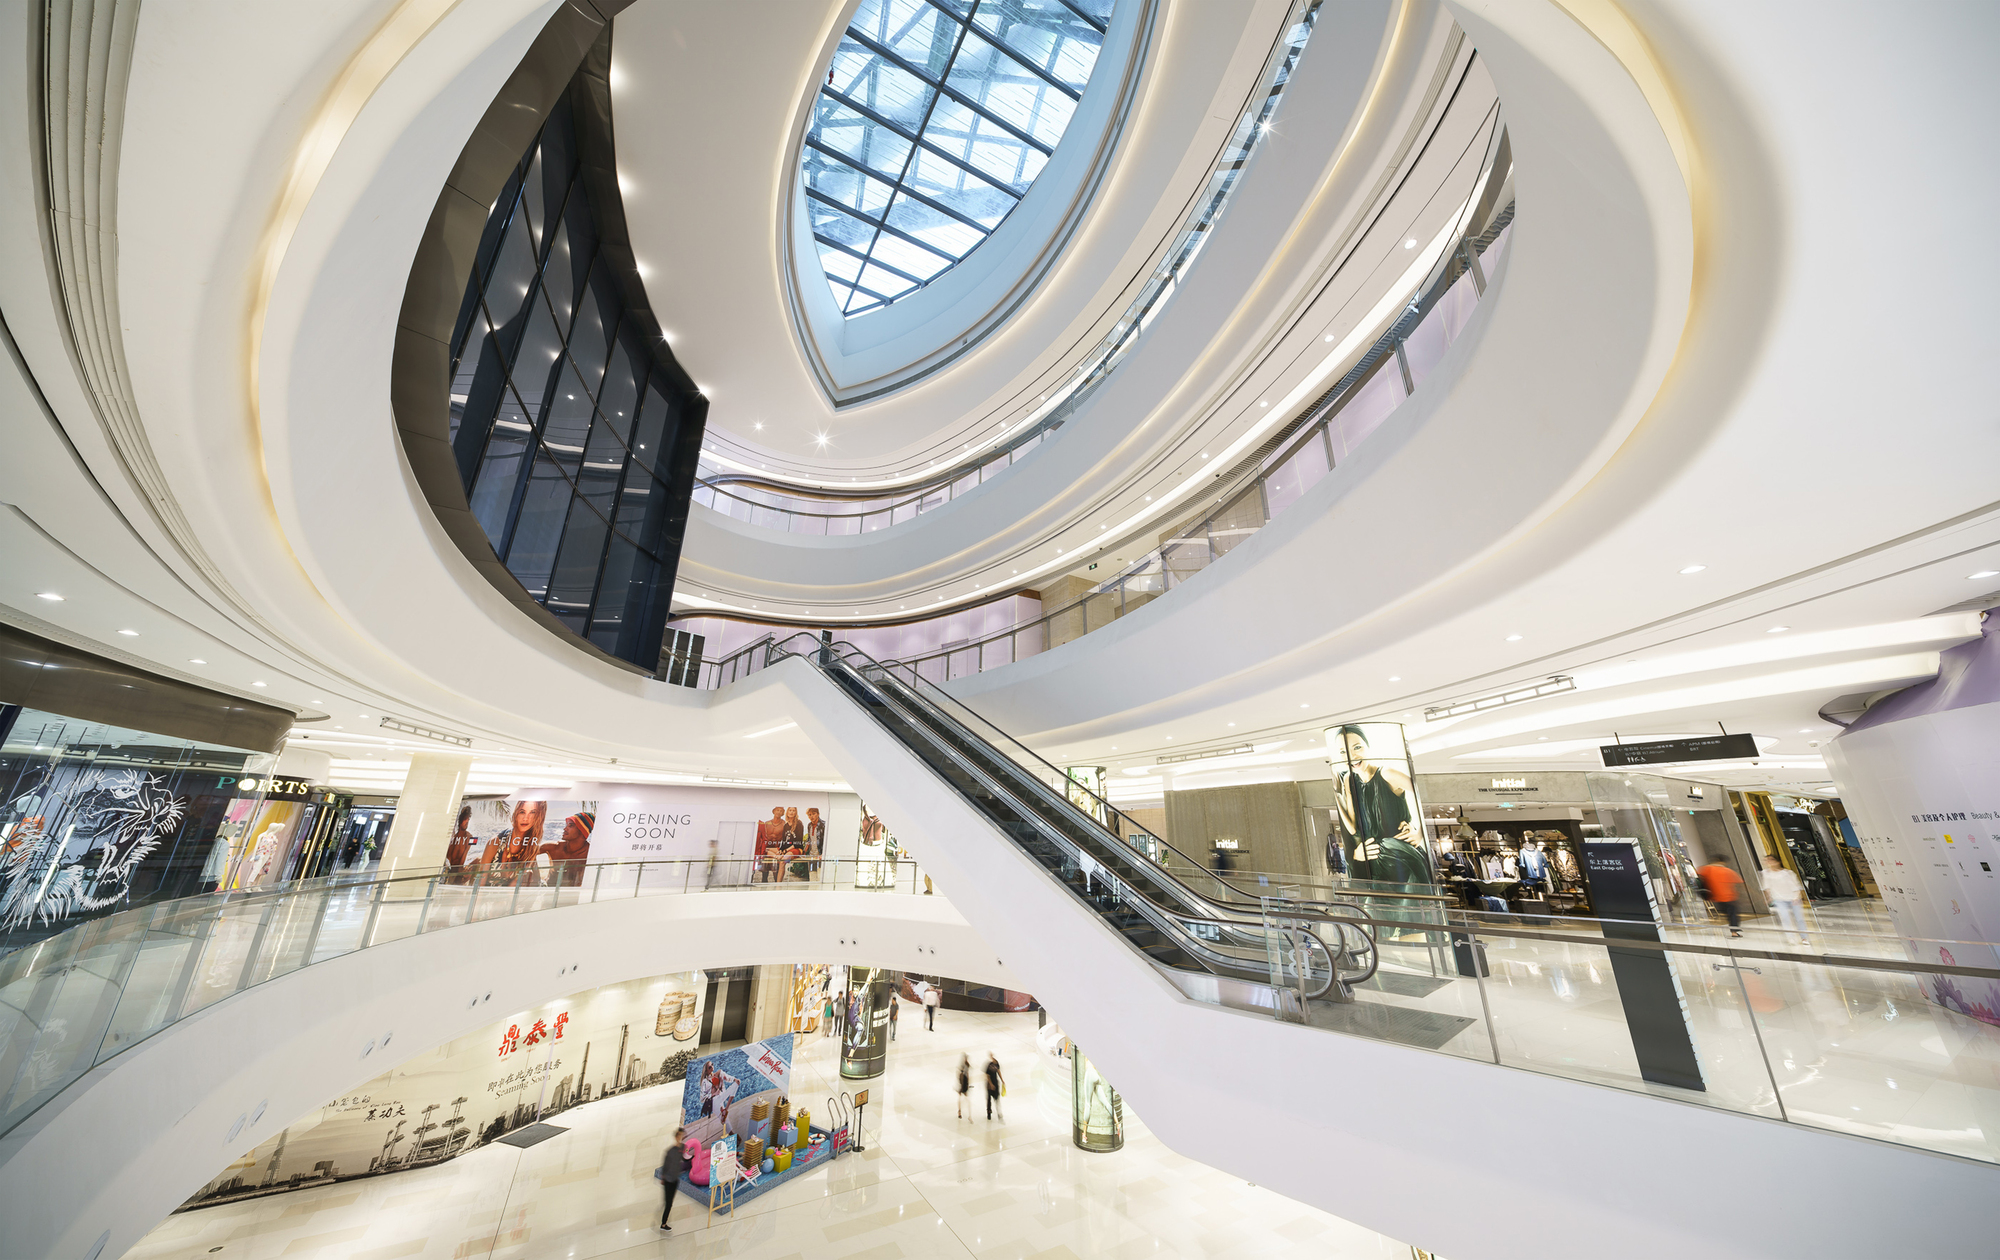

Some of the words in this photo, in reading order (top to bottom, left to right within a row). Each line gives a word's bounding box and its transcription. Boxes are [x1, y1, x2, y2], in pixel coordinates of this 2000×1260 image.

[1492, 778, 1526, 788] initial
[612, 812, 691, 826] OPENING
[1970, 812, 1992, 820] Beauty
[624, 827, 676, 838] SOON
[1215, 839, 1238, 848] initial
